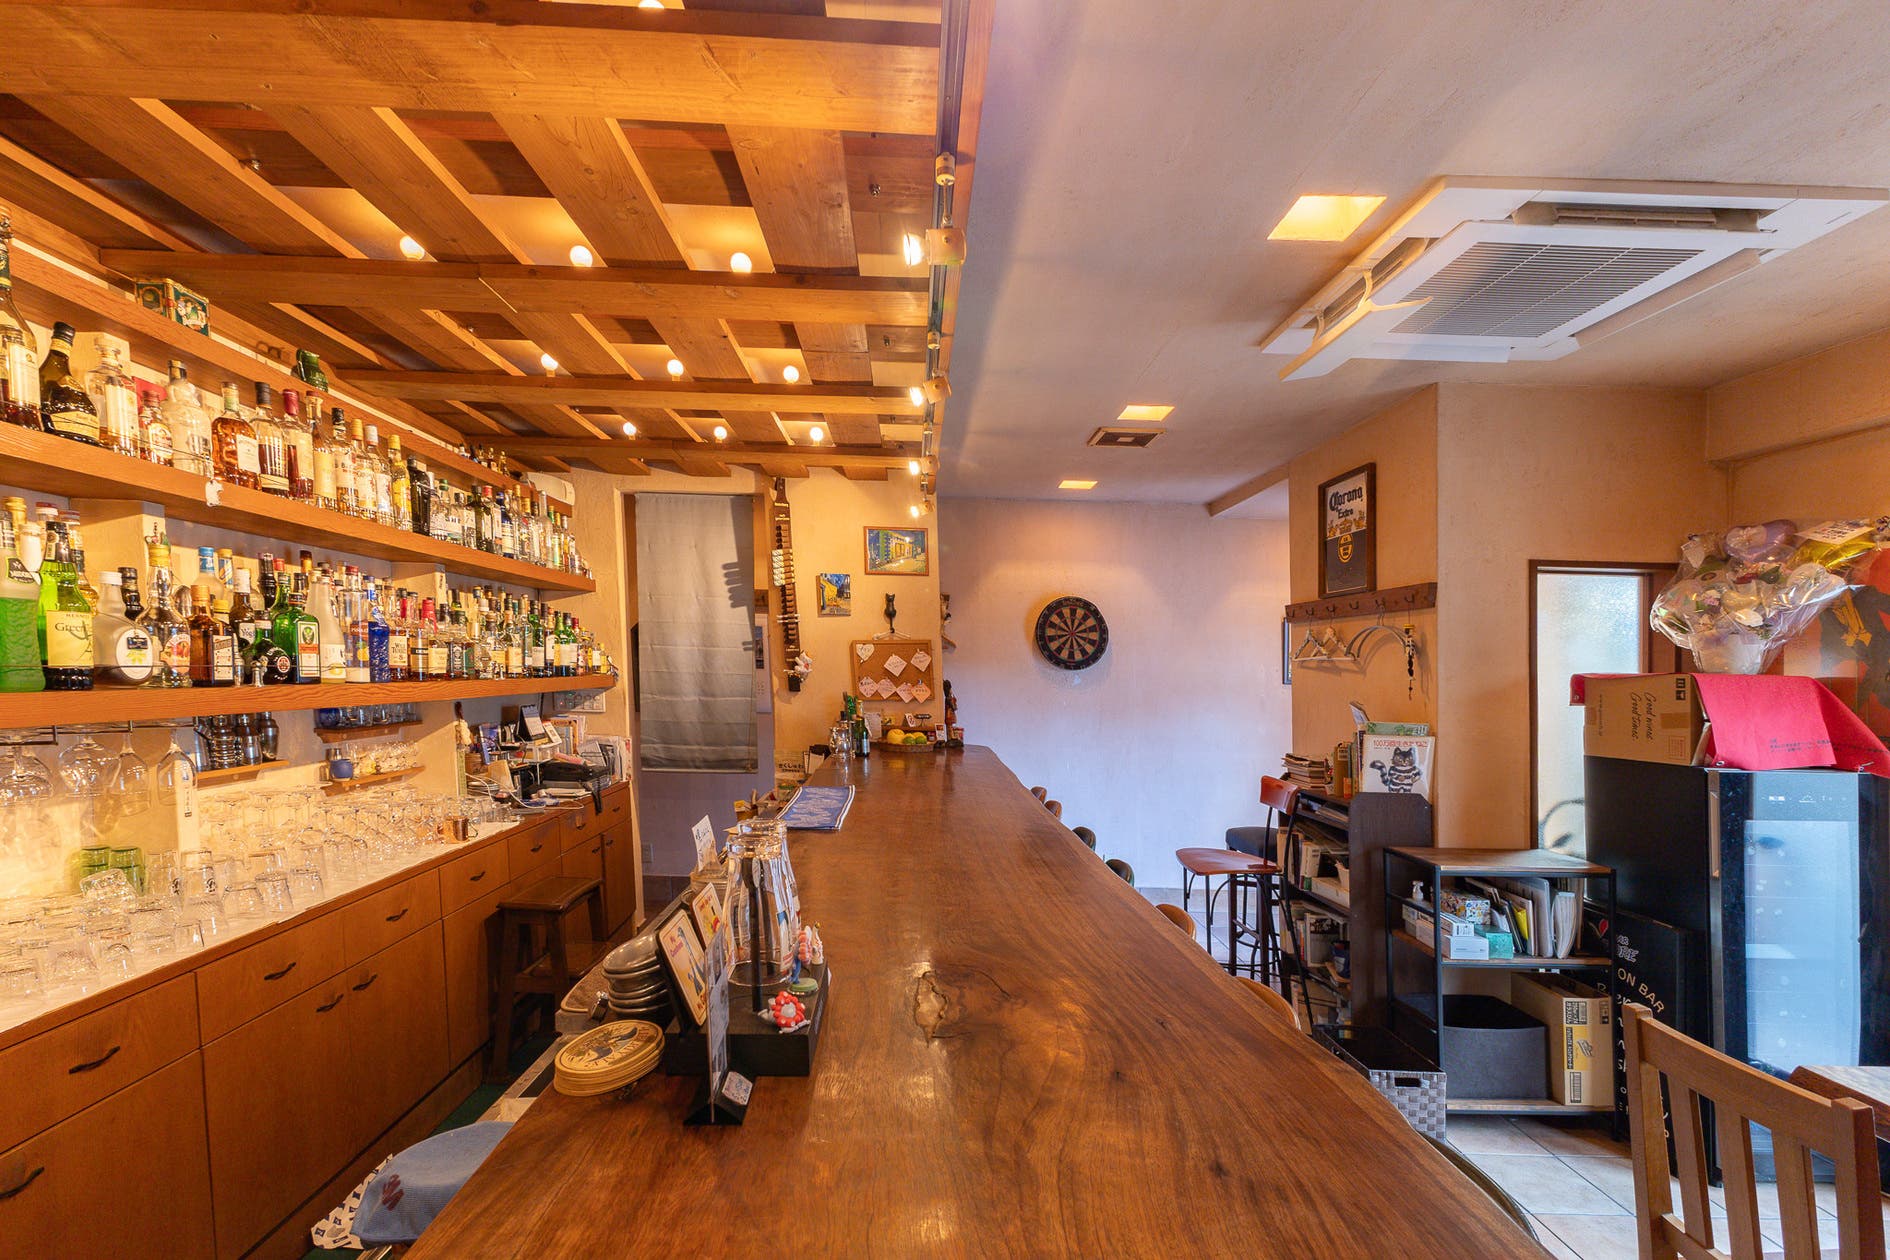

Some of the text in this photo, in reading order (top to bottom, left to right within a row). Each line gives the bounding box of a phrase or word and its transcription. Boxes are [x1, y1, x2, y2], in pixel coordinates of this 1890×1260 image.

[1329, 486, 1363, 512] Corona
[1337, 507, 1354, 519] Extra
[1638, 982, 1665, 1014] BAR
